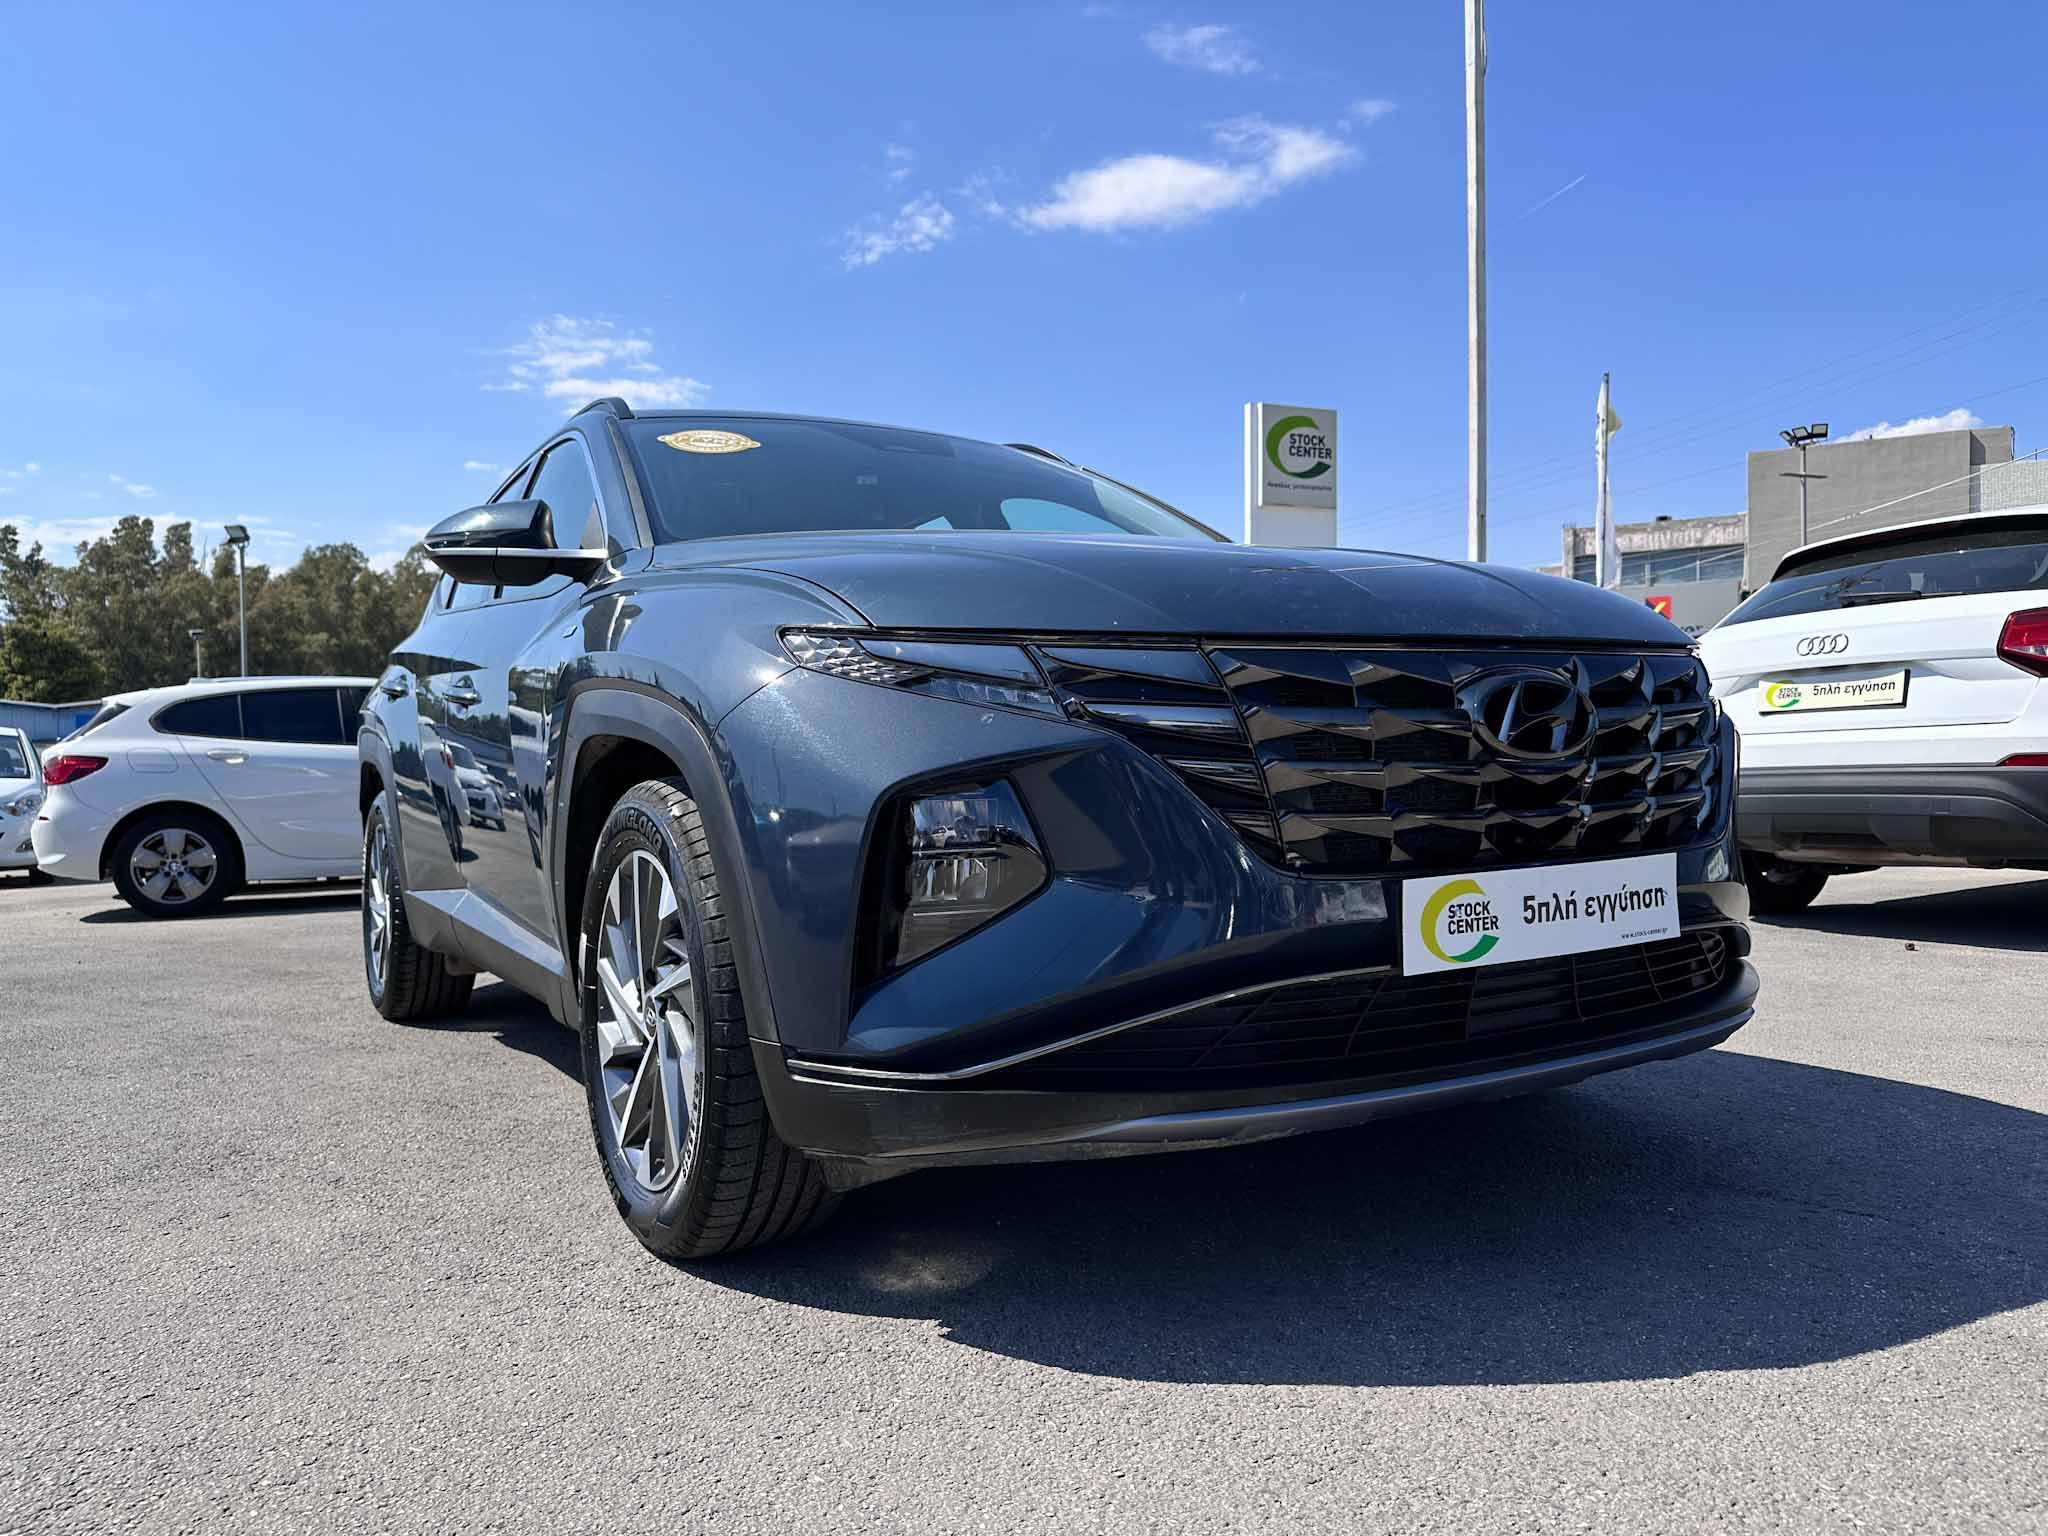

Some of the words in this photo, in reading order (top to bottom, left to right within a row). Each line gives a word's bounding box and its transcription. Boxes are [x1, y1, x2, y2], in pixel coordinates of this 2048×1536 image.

[1289, 433, 1326, 446] STOCK
[1289, 445, 1332, 459] CENTER
[1843, 680, 1896, 697] εγγύηση
[1448, 901, 1491, 919] STOCK
[1522, 890, 1579, 925] 5πλή
[1585, 884, 1666, 924] εγγύηση
[1448, 915, 1500, 935] CENTER
